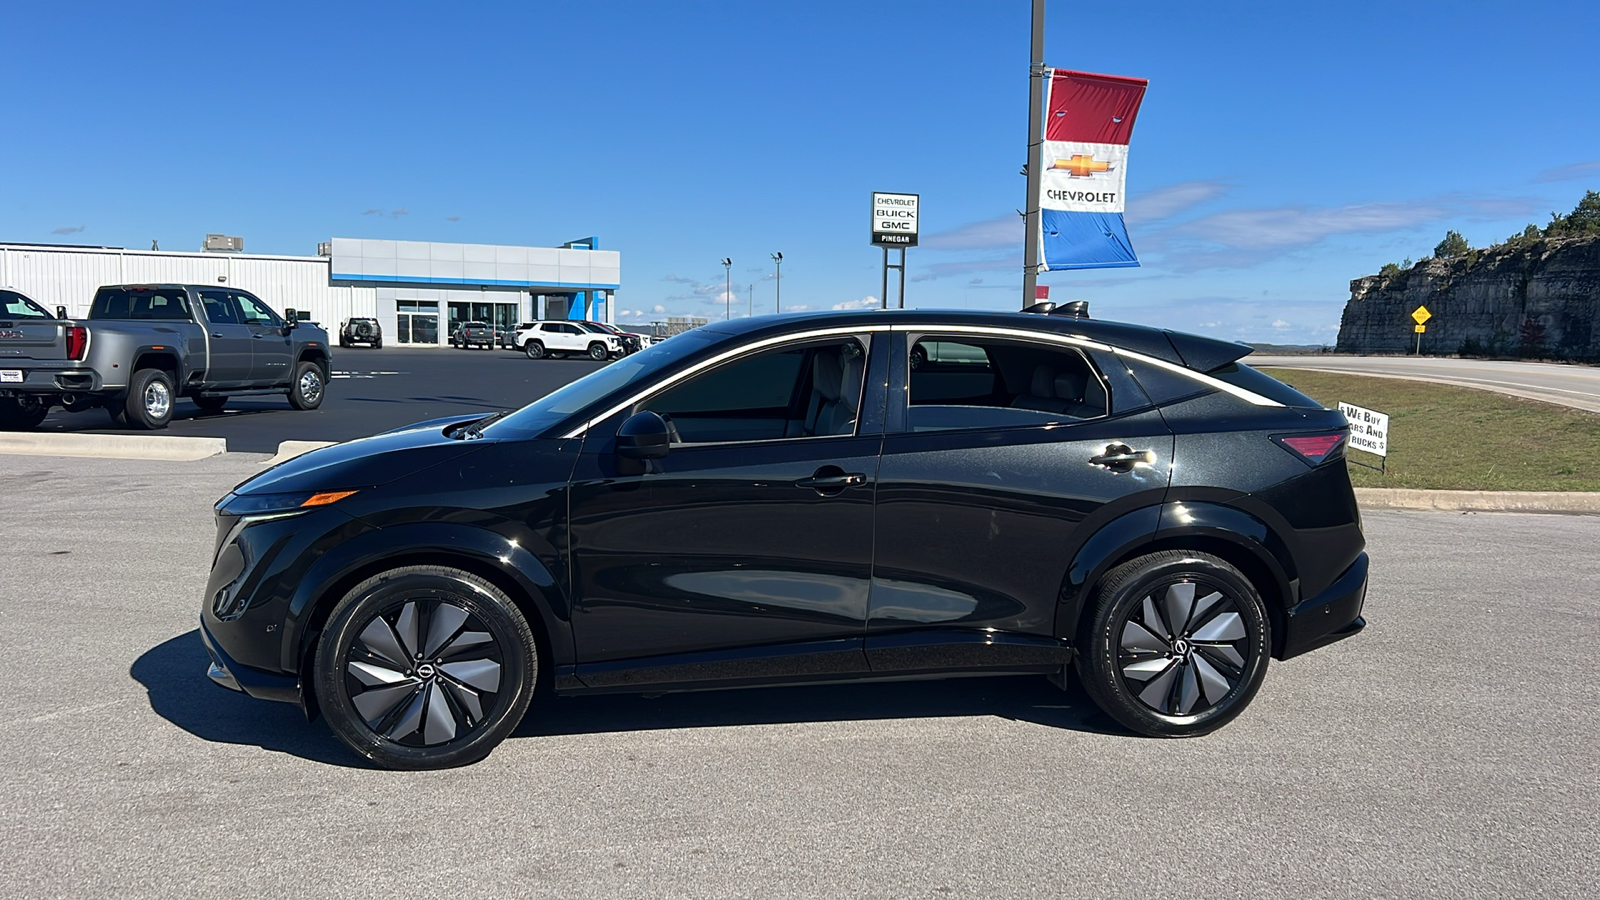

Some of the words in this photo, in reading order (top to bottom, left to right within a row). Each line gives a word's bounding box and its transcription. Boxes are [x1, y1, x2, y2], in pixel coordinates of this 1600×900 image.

[1047, 189, 1116, 203] CHEVROLET
[876, 210, 915, 218] BUICK
[1349, 423, 1364, 433] ARS
[1352, 436, 1377, 449] RUCKS
